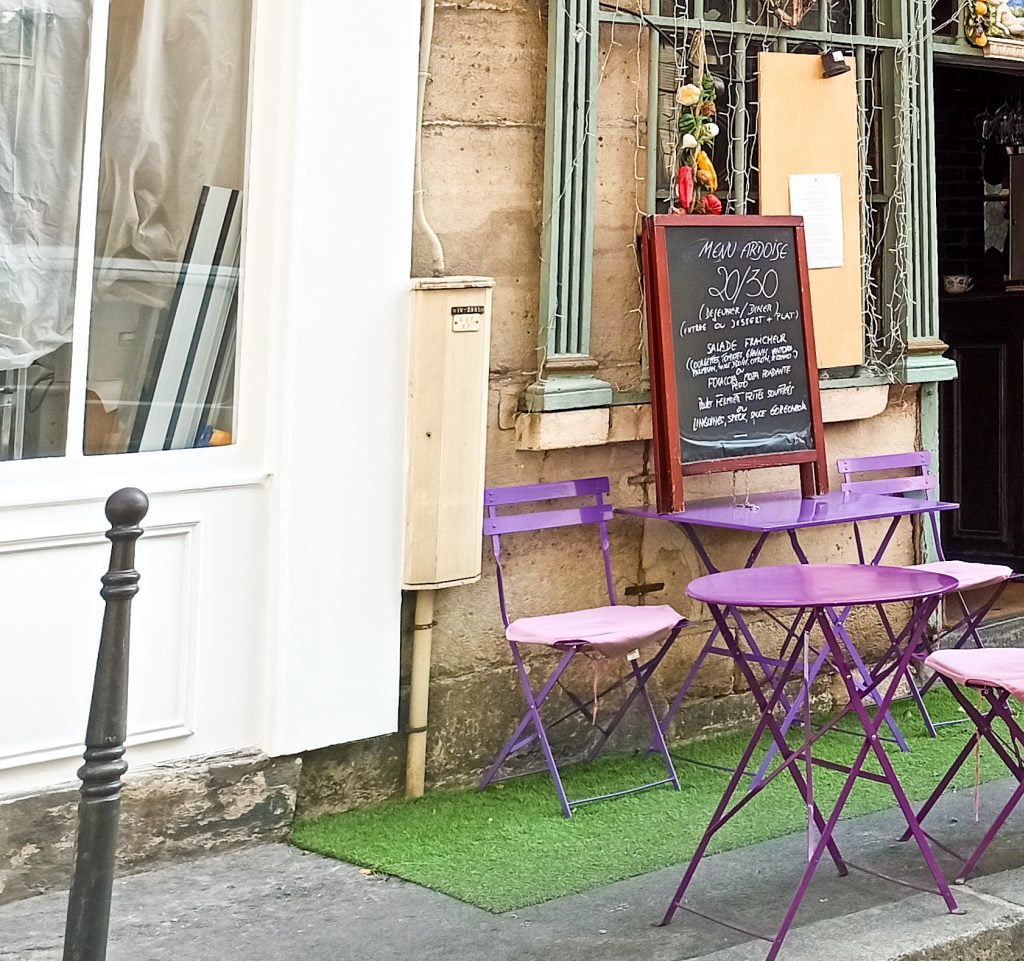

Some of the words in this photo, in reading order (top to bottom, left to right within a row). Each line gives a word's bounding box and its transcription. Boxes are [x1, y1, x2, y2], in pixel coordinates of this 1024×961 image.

[698, 241, 738, 261] MENU
[740, 239, 789, 261] ARDOISE
[708, 265, 779, 304] 20/30
[707, 340, 738, 354] SALADE
